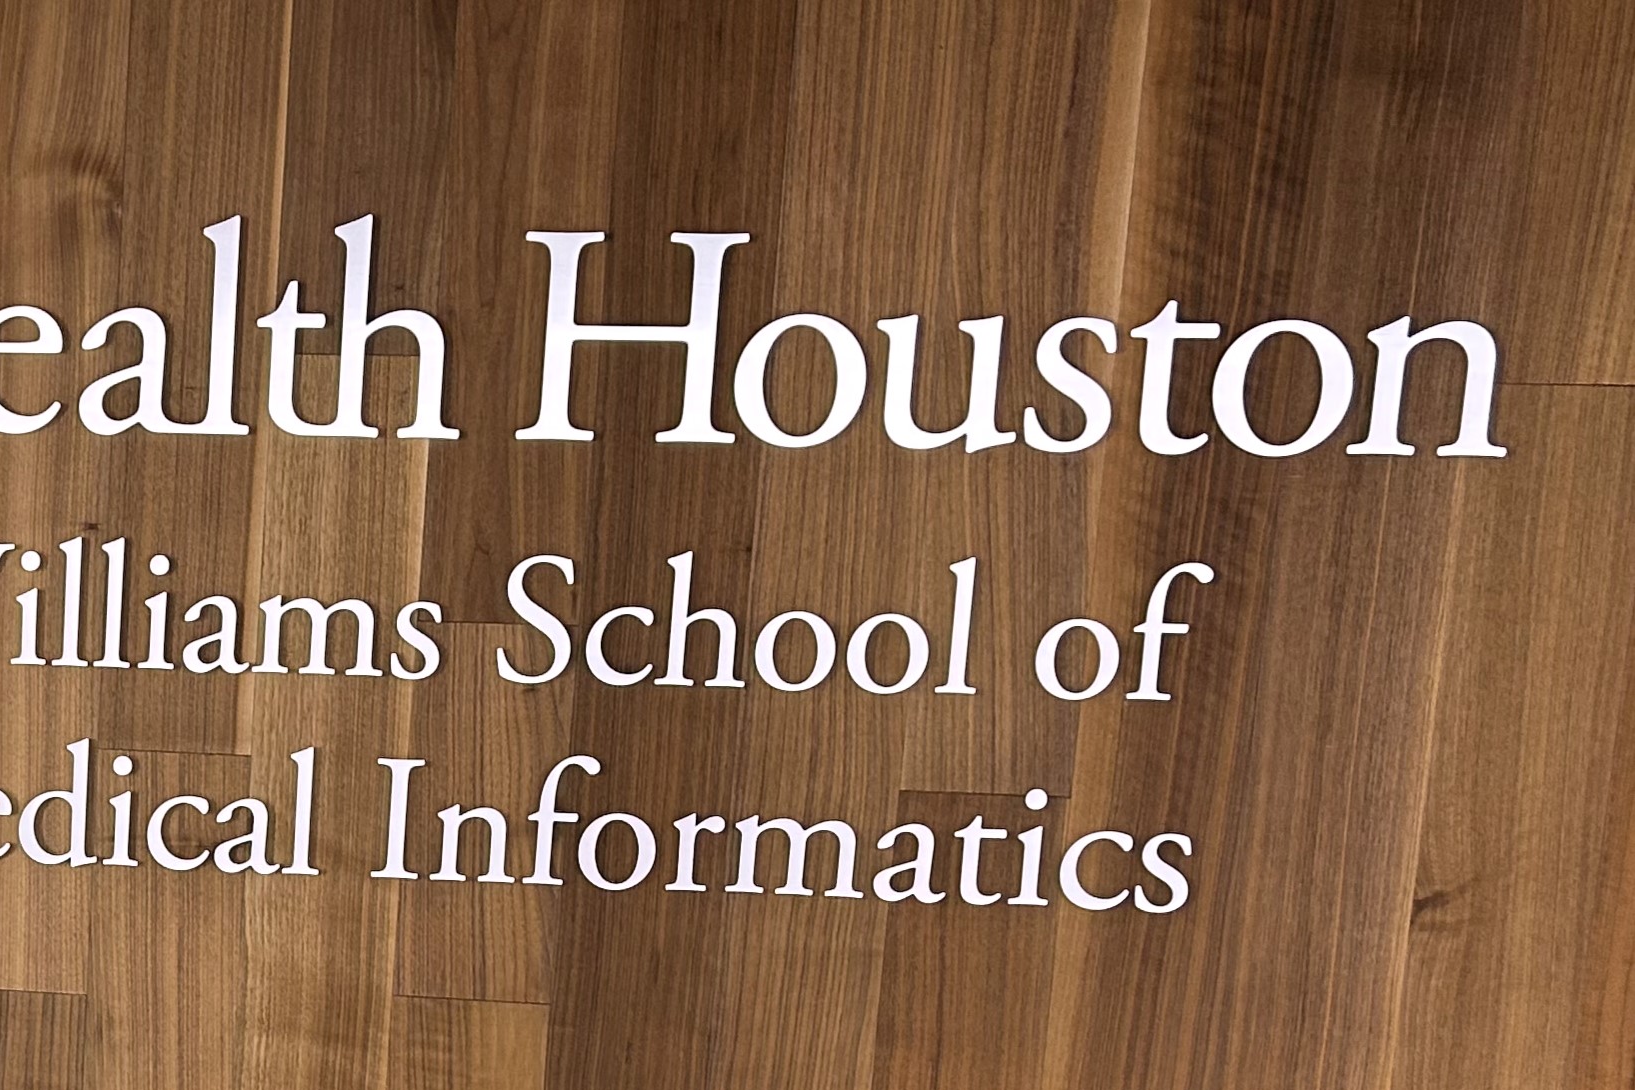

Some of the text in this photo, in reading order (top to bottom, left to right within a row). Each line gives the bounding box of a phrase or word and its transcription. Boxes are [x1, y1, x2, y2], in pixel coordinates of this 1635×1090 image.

[515, 230, 1508, 459] Houston
[495, 553, 977, 696] School
[1034, 561, 1215, 702] of
[369, 754, 1193, 915] Informatics
